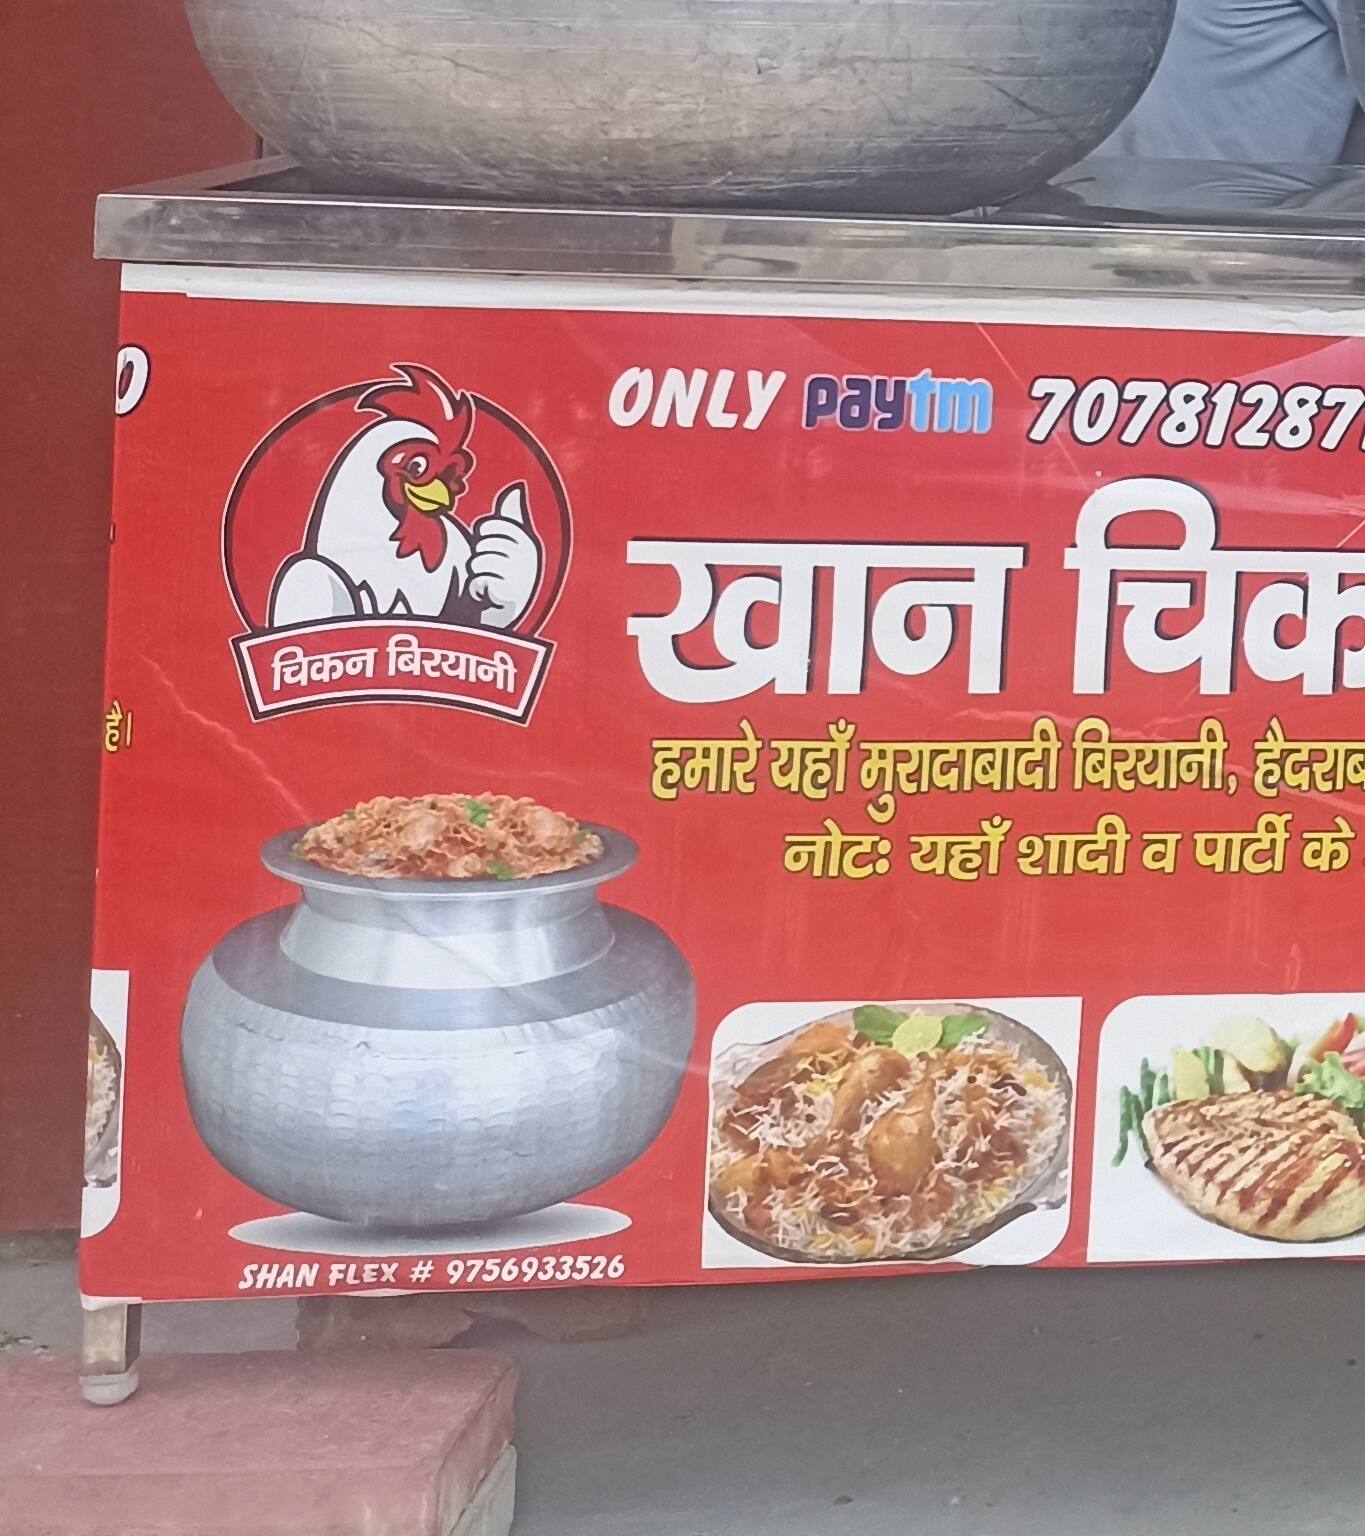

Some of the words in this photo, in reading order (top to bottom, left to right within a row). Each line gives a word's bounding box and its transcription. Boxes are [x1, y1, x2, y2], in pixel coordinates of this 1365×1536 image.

[609, 367, 786, 432] ONLY
[627, 540, 1028, 704] खान
[272, 645, 377, 692] चिकन
[387, 634, 517, 693] बिरयानी
[651, 719, 763, 800] हमारे
[860, 716, 1062, 823] मुरादाबादी
[1073, 717, 1237, 795] बिरयानी,
[1017, 814, 1129, 877] शादी
[1143, 832, 1181, 874] व
[1194, 813, 1292, 873] पार्टी
[1303, 816, 1355, 873] के
[238, 1263, 319, 1290] SHAN
[328, 1261, 401, 1287] FLEX
[446, 1255, 625, 1285] 9756933526
